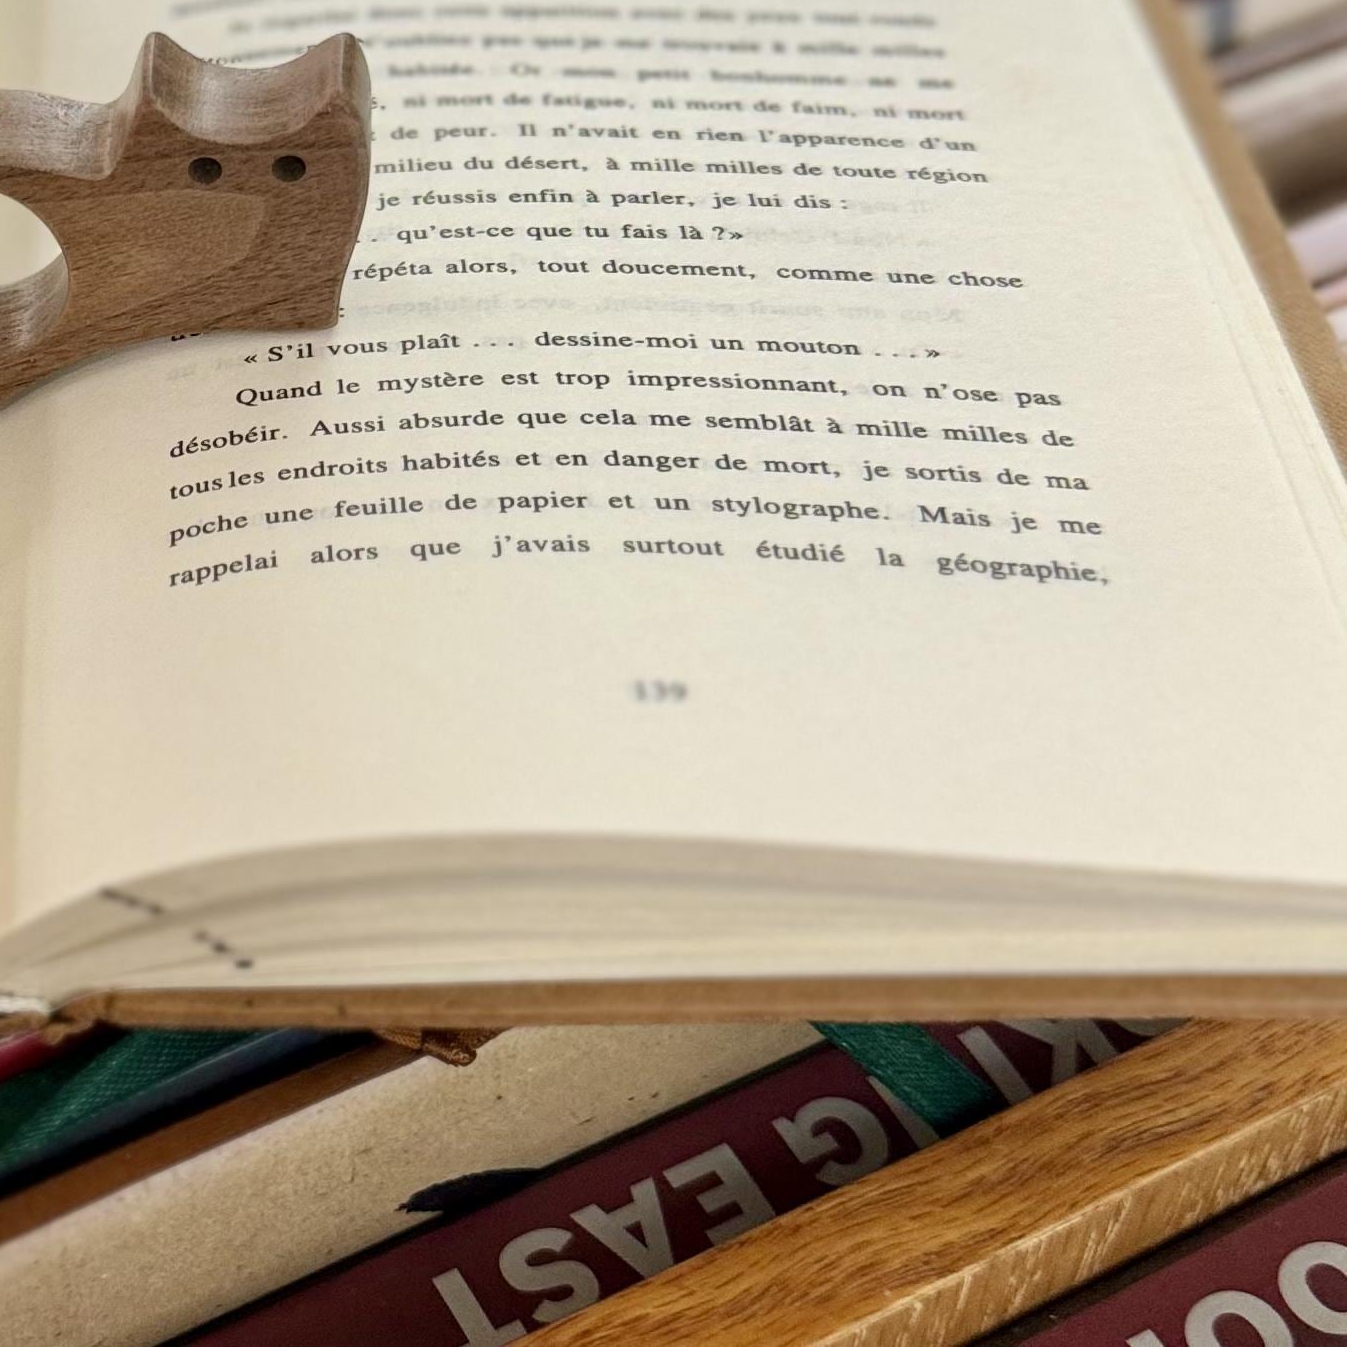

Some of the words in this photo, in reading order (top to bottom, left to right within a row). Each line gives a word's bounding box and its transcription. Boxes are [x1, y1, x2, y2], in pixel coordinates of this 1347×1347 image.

[374, 191, 402, 213] je
[410, 188, 499, 207] réussis
[507, 187, 576, 205] enfin
[584, 187, 602, 205] à
[608, 189, 697, 209] parler,
[710, 190, 742, 211] je
[745, 191, 785, 209] lui
[792, 193, 833, 211] dis
[524, 225, 574, 243] que
[581, 224, 612, 240] tu
[618, 222, 670, 241] fais
[676, 223, 706, 242] là
[350, 259, 435, 284] répéta
[444, 257, 519, 277] alors,
[535, 258, 592, 275] tout
[600, 258, 759, 282] doucement,
[775, 266, 876, 284] comme
[884, 271, 939, 286] une
[946, 269, 1026, 290] chose
[324, 340, 390, 357] vous
[397, 331, 462, 357] plaît
[533, 329, 700, 351] dessine-moi
[707, 337, 747, 352] un
[754, 338, 864, 357] mouton
[234, 379, 324, 408] Quand
[334, 377, 362, 396] le
[375, 370, 486, 396] mystère
[499, 370, 542, 387] est
[553, 370, 612, 391] trop
[625, 368, 851, 398] impressionnant,
[870, 382, 909, 399] on
[1012, 390, 1064, 410] pas
[168, 423, 290, 460] désobéir.
[308, 414, 387, 438] Aussi
[397, 408, 506, 432] absurde
[515, 411, 570, 431] que
[578, 407, 639, 427] cela
[646, 412, 693, 429] me
[703, 412, 817, 434] semblât
[824, 415, 846, 436] à
[853, 418, 930, 440] mille
[939, 423, 1030, 446] milles
[1040, 428, 1077, 449] de
[168, 476, 225, 502] tous
[226, 469, 267, 490] les
[276, 455, 389, 482] endroits
[399, 448, 502, 473] habités
[513, 450, 544, 468] et
[553, 452, 590, 468] en
[602, 448, 702, 474] danger
[713, 452, 750, 473] de
[760, 458, 843, 480] mort,
[861, 458, 894, 483] je
[903, 463, 984, 485] sortis
[995, 466, 1033, 488] de
[1042, 474, 1093, 492] ma
[168, 513, 250, 550] poche
[263, 506, 318, 526] une
[332, 494, 425, 520] feuille
[443, 492, 479, 512] de
[495, 489, 590, 515] papier
[606, 493, 637, 511] et
[652, 496, 693, 513] un
[710, 495, 892, 524] stylographe.
[915, 503, 994, 529] Mais
[1009, 509, 1040, 536] je
[1055, 518, 1104, 537] me
[168, 548, 280, 589] rappelai
[309, 543, 380, 566] alors
[408, 540, 463, 563] que
[621, 537, 726, 558] surtout
[754, 538, 847, 564] étudié
[873, 545, 907, 569] la
[934, 551, 1111, 587] géographie,
[432, 1143, 776, 1347] EAST
